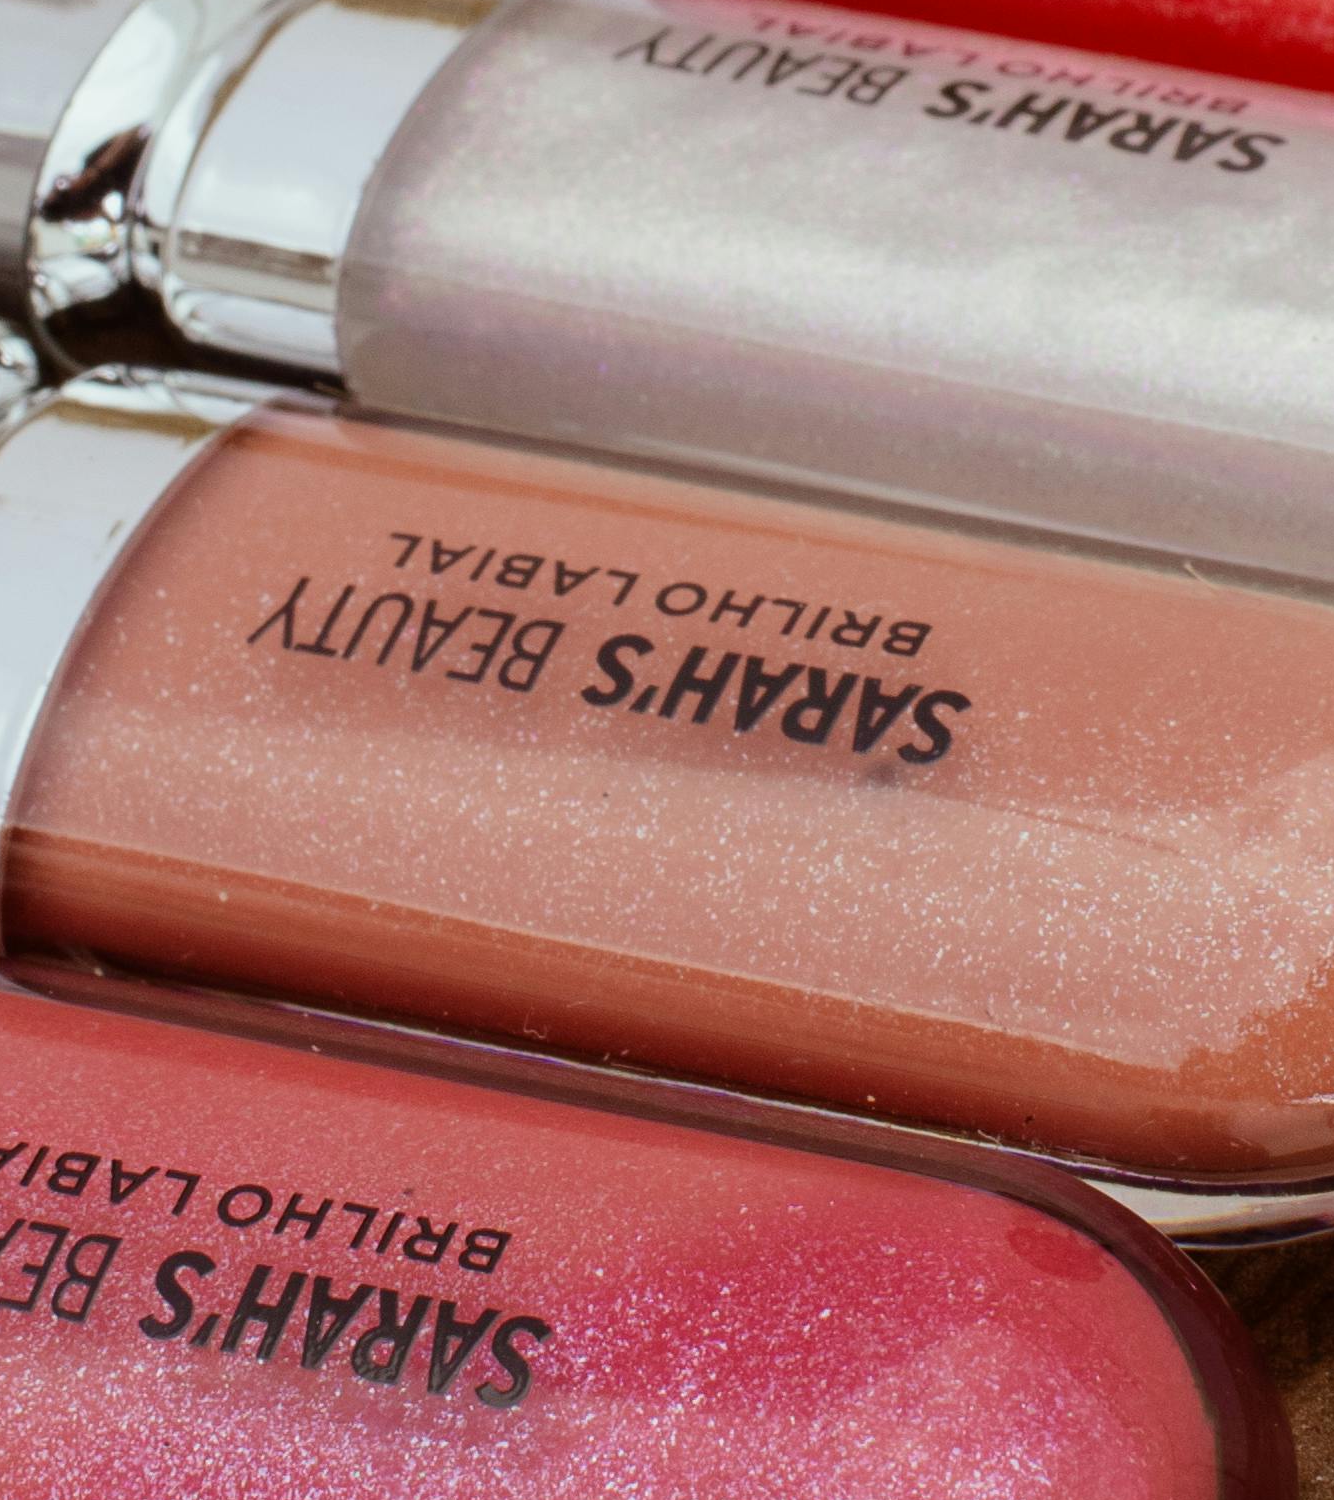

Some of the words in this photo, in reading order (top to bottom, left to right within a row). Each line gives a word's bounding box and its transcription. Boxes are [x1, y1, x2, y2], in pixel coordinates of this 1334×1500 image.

[614, 28, 912, 105] BEAUTY
[754, 13, 972, 69] LABIAL
[924, 79, 1287, 173] SARAH'S
[997, 59, 1249, 115] BRILHO
[387, 532, 641, 605] LABIAL
[247, 576, 567, 693] BEAUTY
[653, 580, 933, 658] BRILHO
[581, 633, 972, 765] SARAH'S
[215, 1182, 512, 1275] BRILHO
[138, 1249, 553, 1411] SARAH'S
